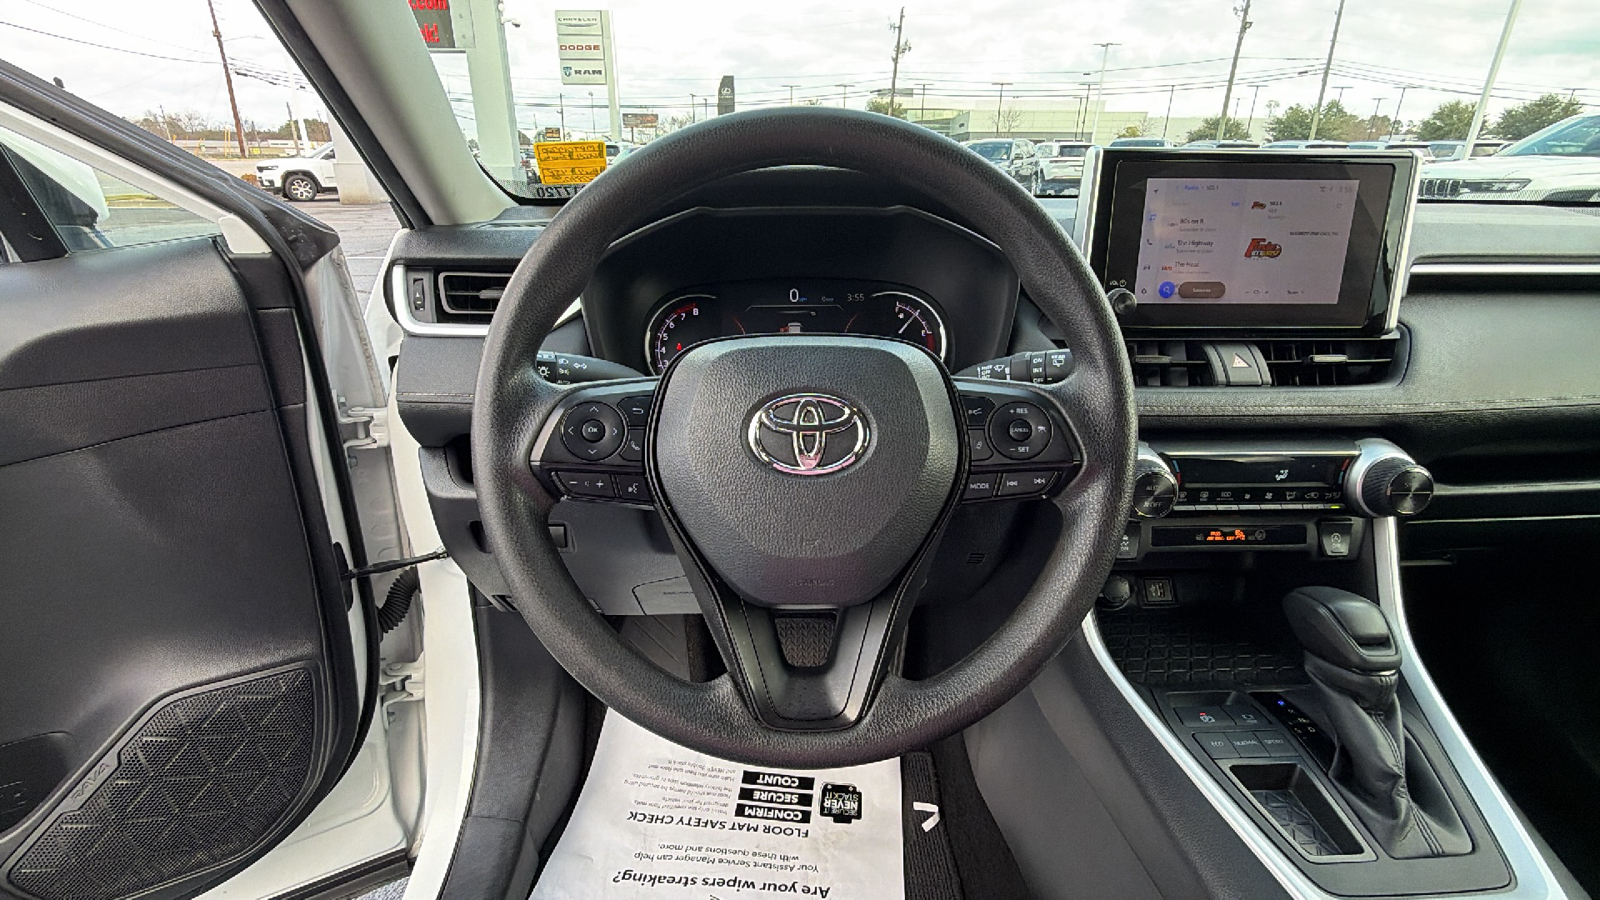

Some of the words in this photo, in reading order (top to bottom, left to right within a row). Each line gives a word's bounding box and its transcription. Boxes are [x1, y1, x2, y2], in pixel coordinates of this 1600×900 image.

[790, 288, 799, 302] 0
[847, 294, 864, 302] 3:55
[663, 360, 669, 368] 3
[757, 774, 799, 786] COUNT
[753, 791, 799, 803] SECURE
[834, 792, 858, 800] STACK
[824, 798, 858, 810] NEVER
[626, 811, 674, 824] CHECK
[744, 806, 802, 820] CONFIRM
[831, 808, 858, 816] SECURE
[676, 816, 727, 830] SAFETY
[728, 822, 759, 832] MAT
[762, 824, 809, 838] FLOOR
[634, 852, 654, 862] help
[704, 847, 750, 856] questions
[752, 852, 777, 860] these
[674, 854, 715, 864] Manager
[718, 858, 752, 868] Service
[753, 861, 796, 872] Assistant
[796, 864, 818, 872] Your
[612, 870, 698, 887] streaking?
[701, 876, 756, 892] wipers
[758, 881, 798, 894] your
[801, 884, 830, 899] Are
